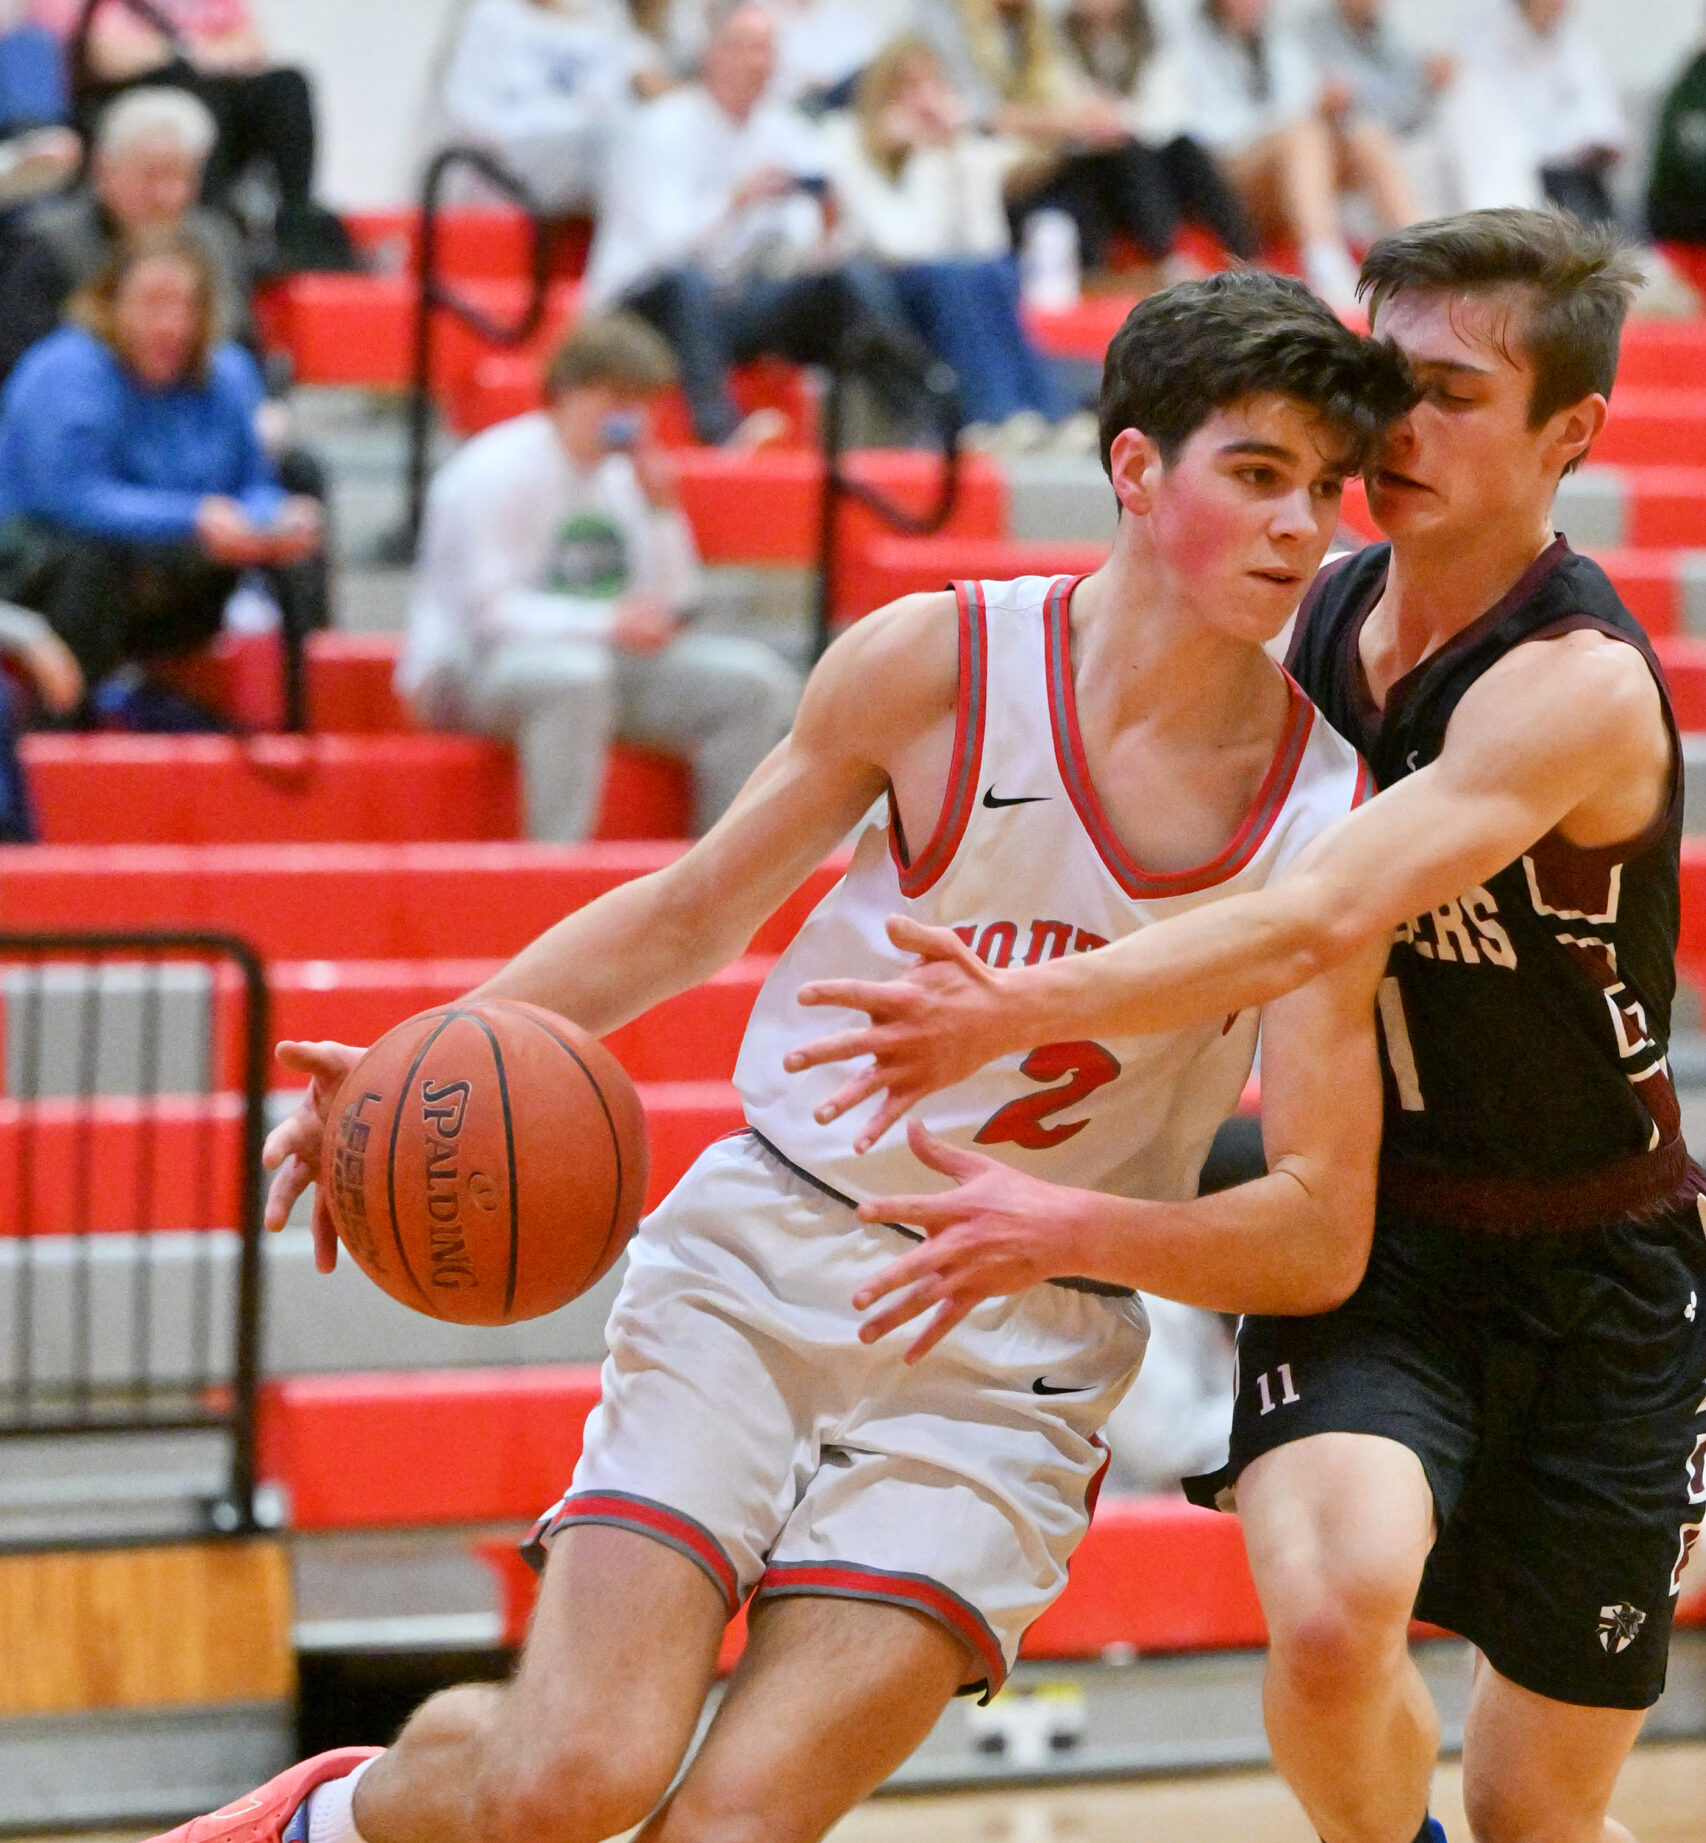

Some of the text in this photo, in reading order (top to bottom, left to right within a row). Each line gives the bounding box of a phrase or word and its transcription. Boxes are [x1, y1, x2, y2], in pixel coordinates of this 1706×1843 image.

[972, 1039, 1122, 1150] 2
[421, 1079, 478, 1290] SPALDING
[1256, 1363, 1300, 1416] 11
